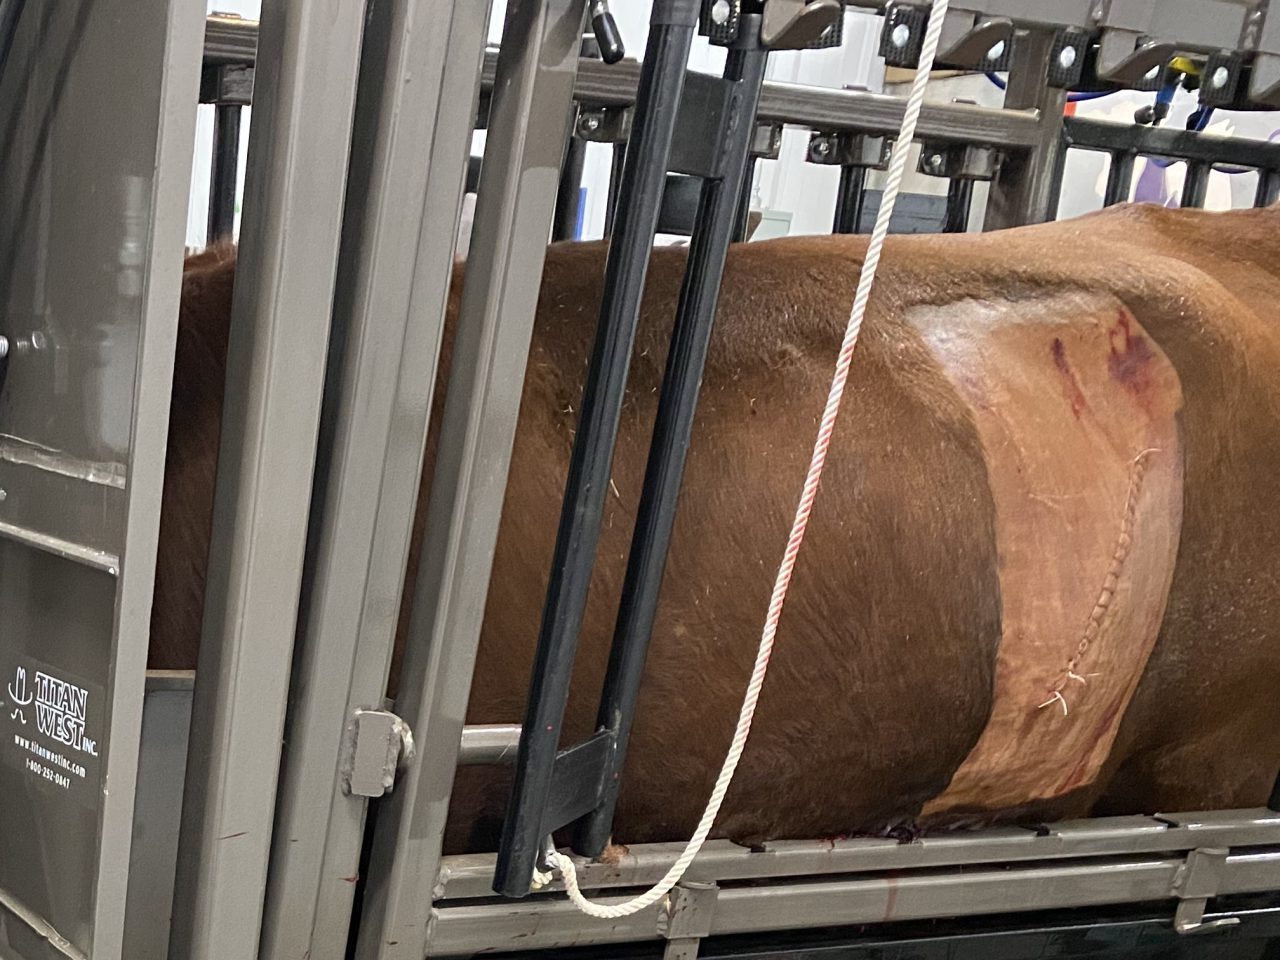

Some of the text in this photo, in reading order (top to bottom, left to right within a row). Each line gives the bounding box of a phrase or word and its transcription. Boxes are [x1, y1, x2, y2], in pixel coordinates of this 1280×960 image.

[34, 671, 88, 721] TITAN
[35, 701, 85, 750] WEST
[14, 734, 86, 778] www.titanwestinc.com
[26, 758, 71, 789] 1-800-252-0847
